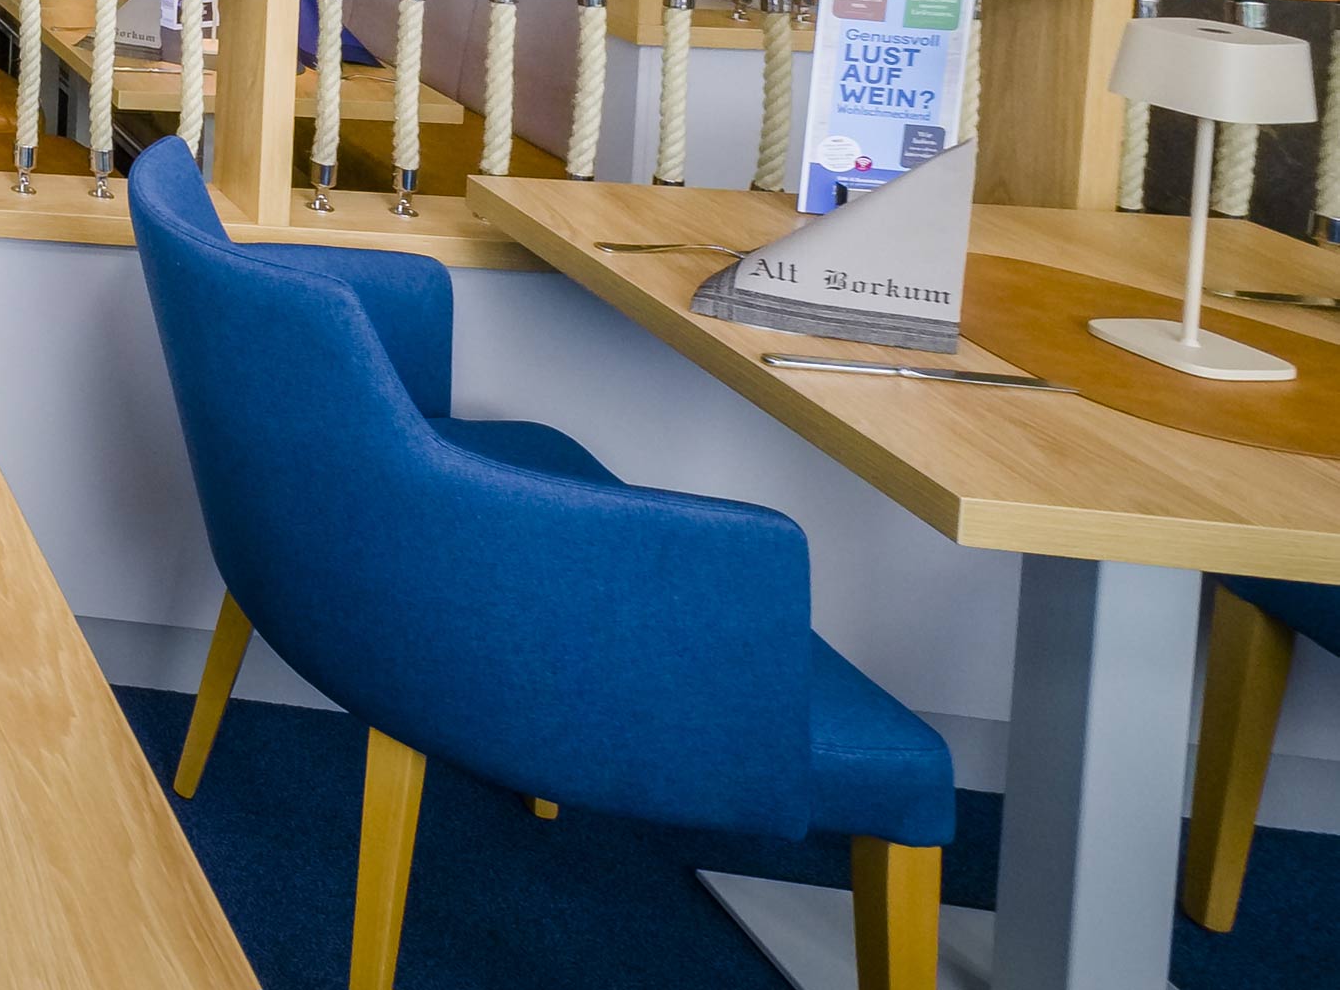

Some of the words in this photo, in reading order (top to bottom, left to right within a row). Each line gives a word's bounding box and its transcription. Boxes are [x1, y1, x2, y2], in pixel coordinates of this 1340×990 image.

[115, 29, 156, 43] orkum
[845, 28, 941, 47] Genussvoll
[844, 43, 921, 66] LUST
[841, 64, 903, 86] AUF
[839, 83, 935, 110] WEIN?
[837, 104, 931, 121] Wohlschmeckend
[748, 258, 799, 283] Alt
[823, 269, 952, 305] Borkum
